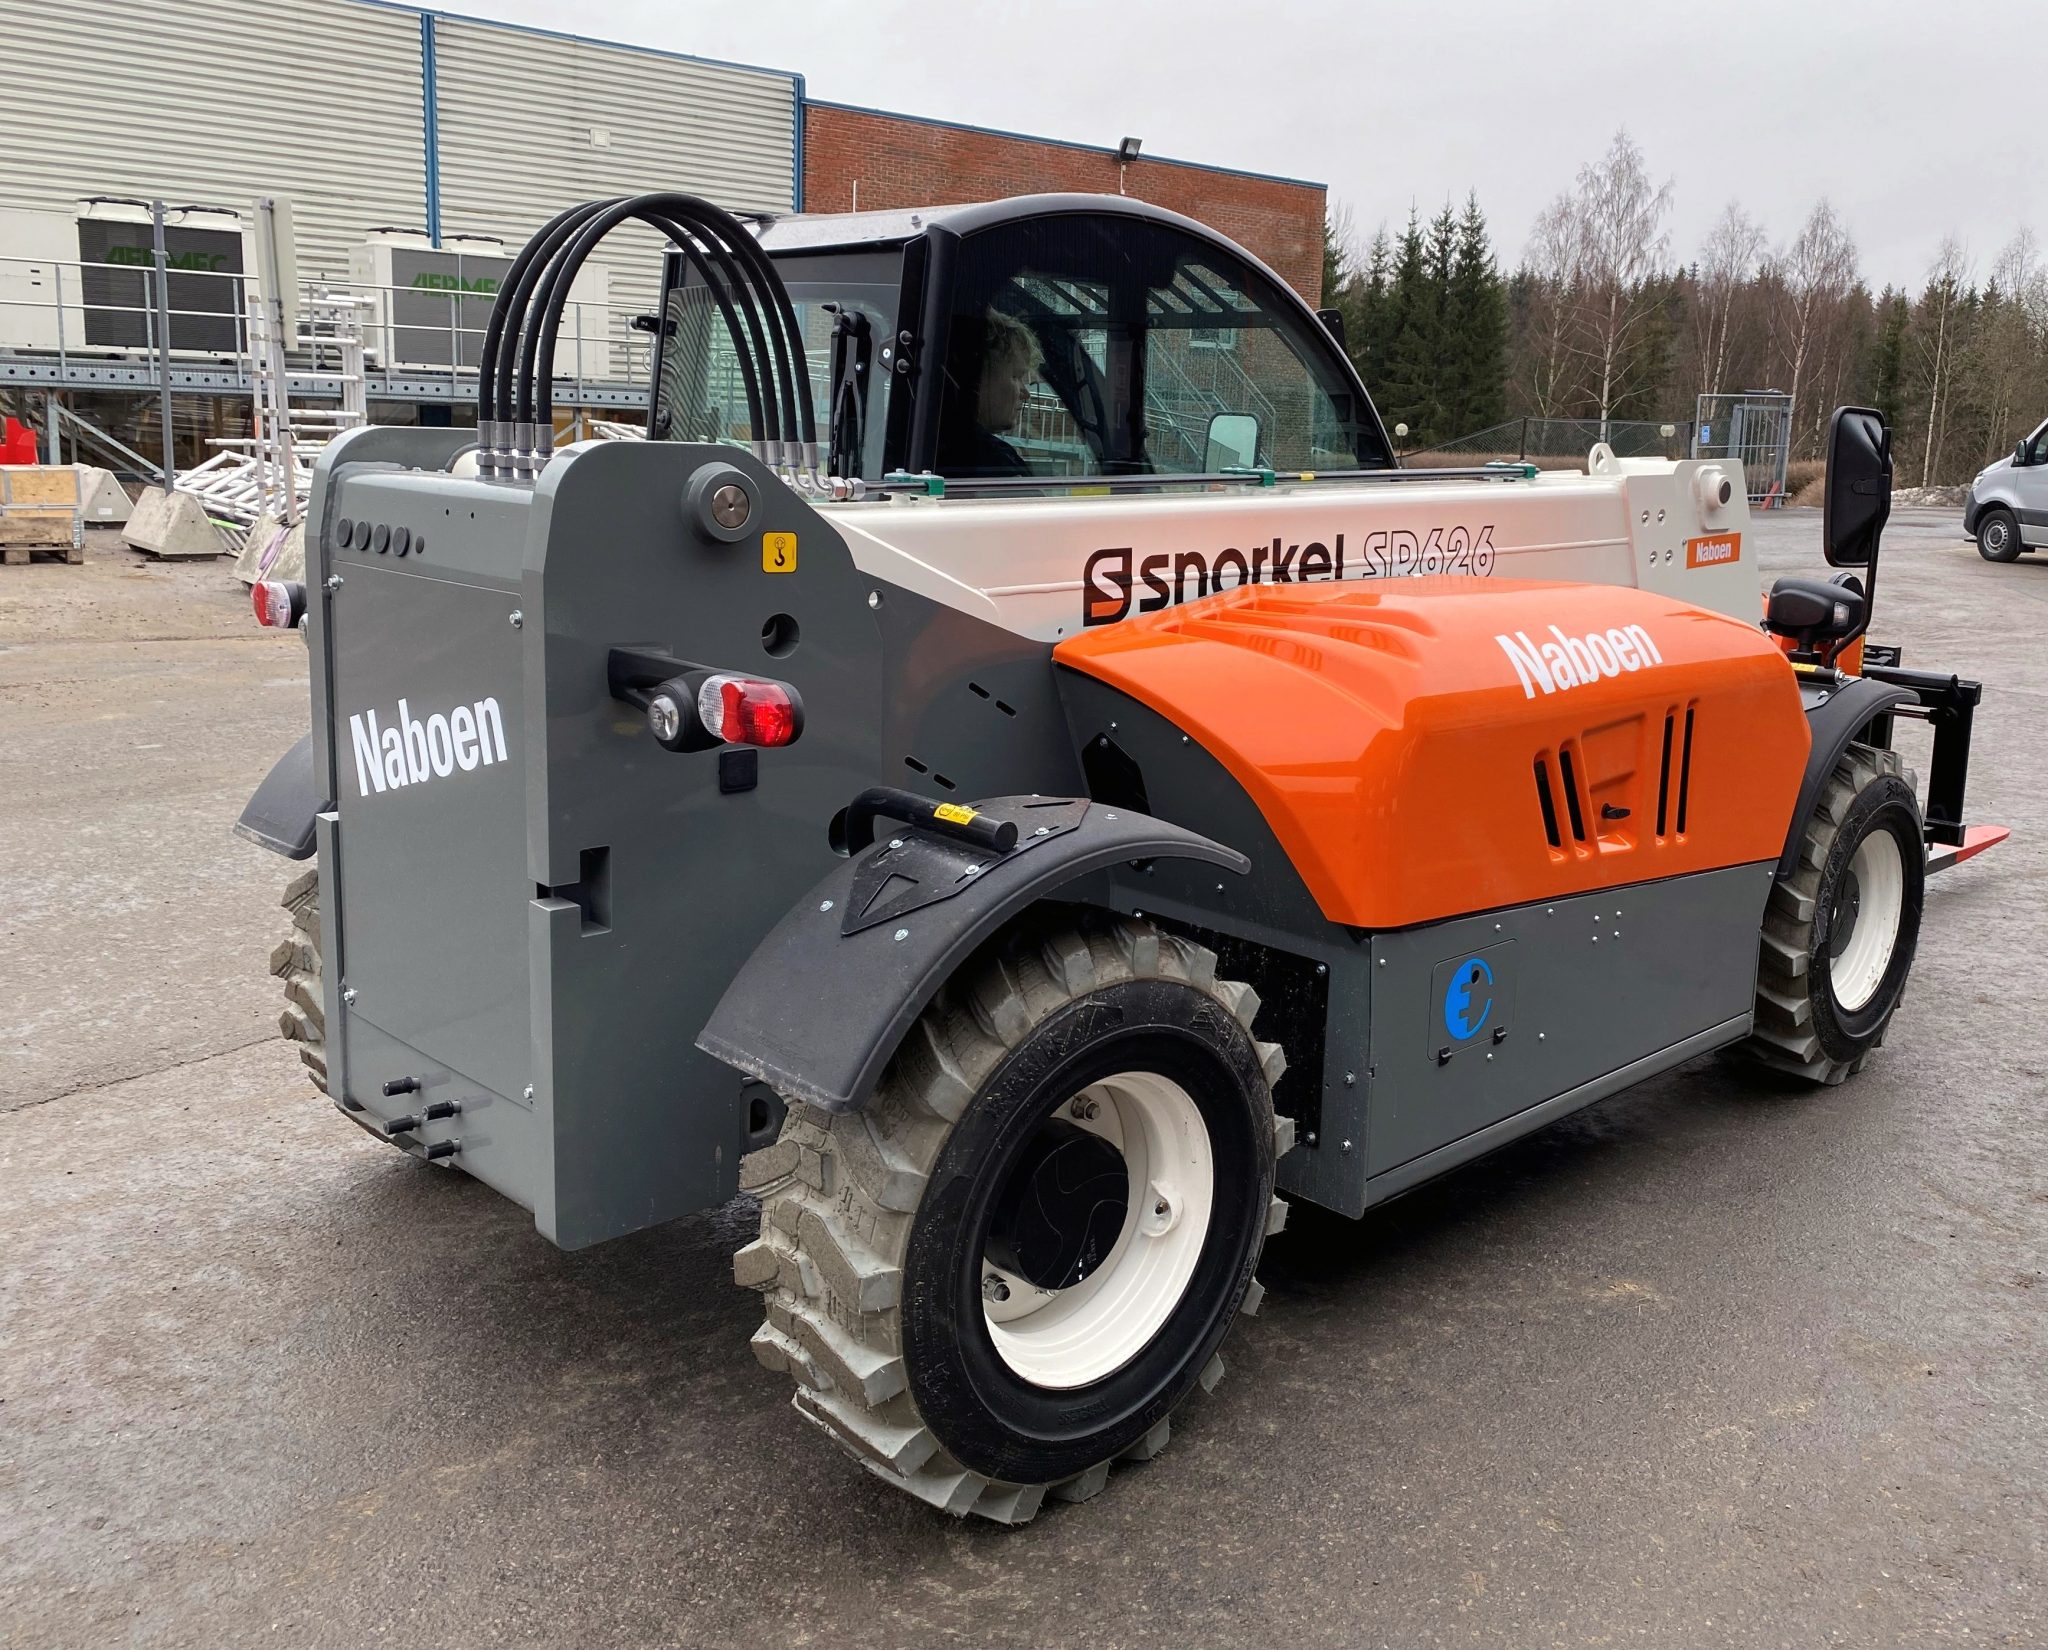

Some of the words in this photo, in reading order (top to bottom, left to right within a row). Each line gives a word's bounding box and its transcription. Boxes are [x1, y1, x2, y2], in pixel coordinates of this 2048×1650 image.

[407, 272, 503, 302] AERME
[1139, 533, 1345, 613] snorkel
[1362, 525, 1496, 577] SR626
[1695, 540, 1732, 562] Naboen
[1494, 624, 1663, 700] Naboen
[349, 696, 508, 797] Naboen
